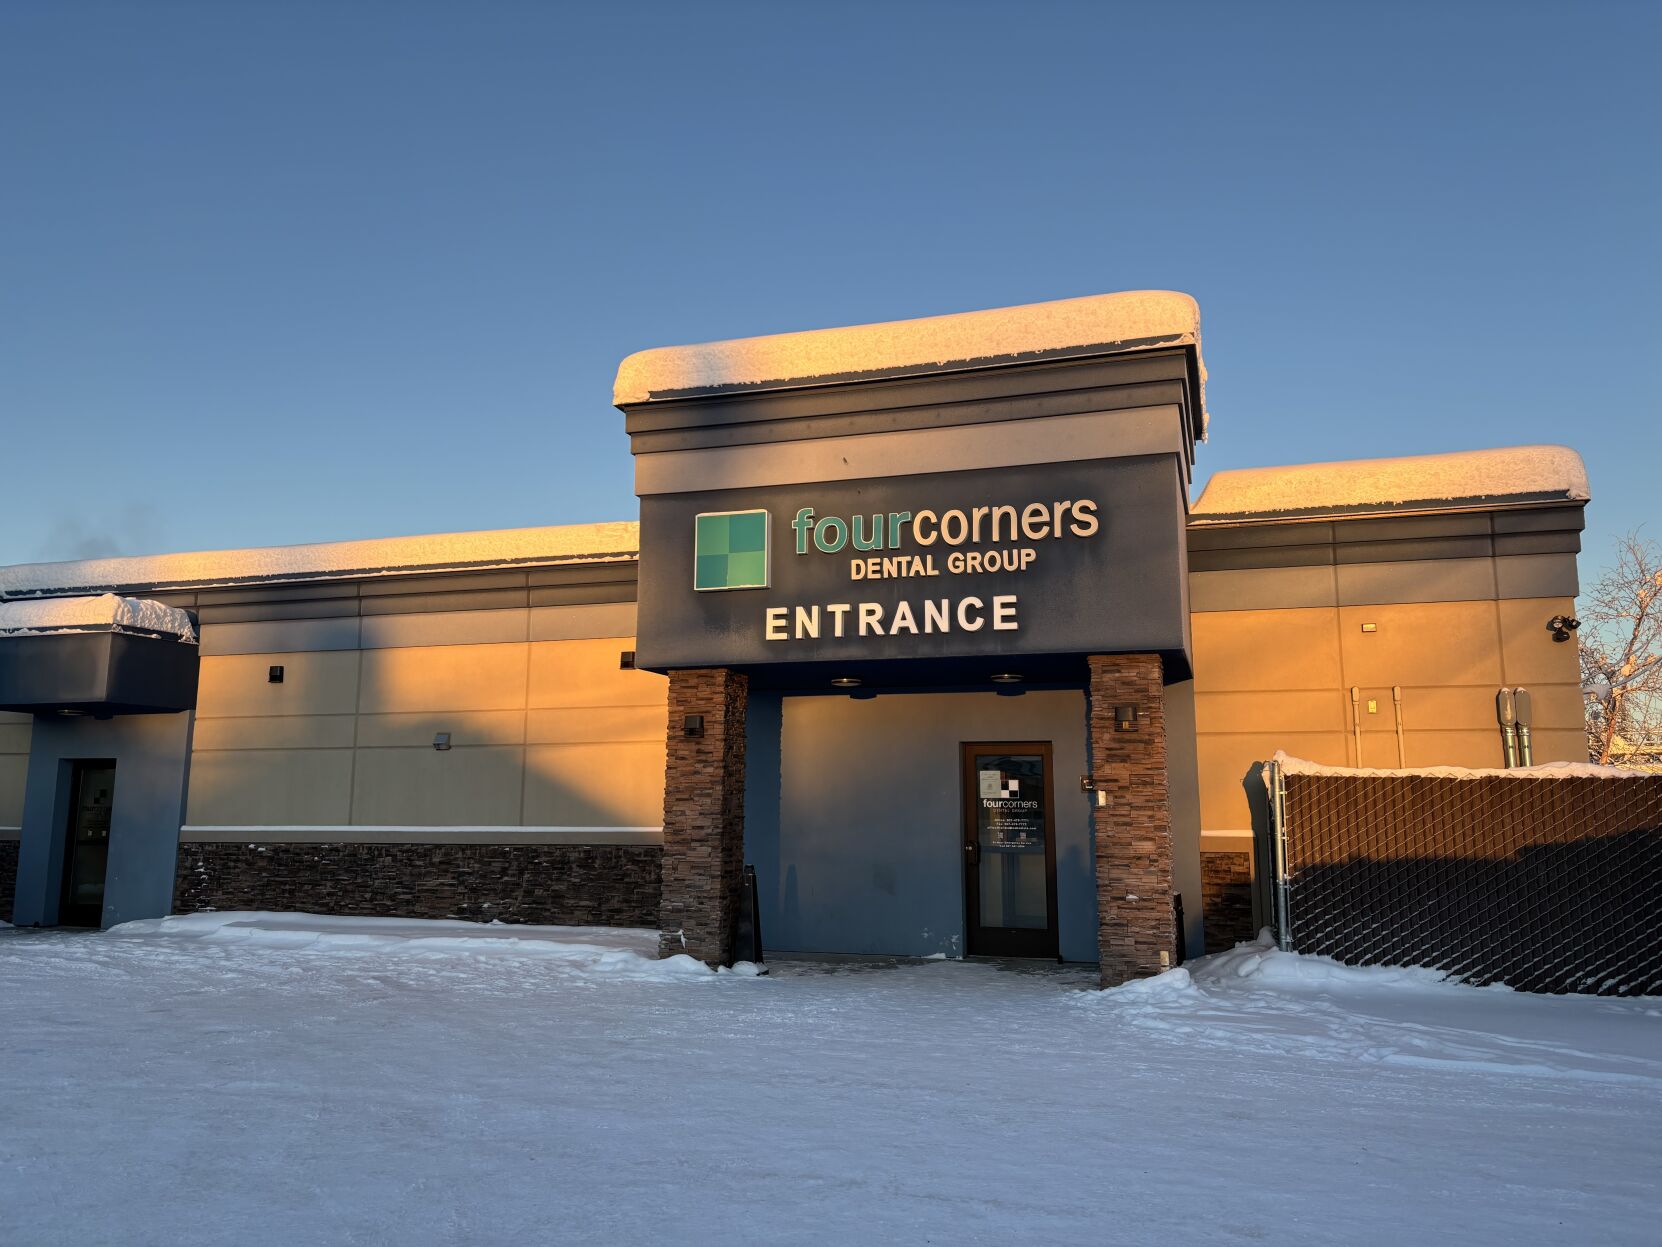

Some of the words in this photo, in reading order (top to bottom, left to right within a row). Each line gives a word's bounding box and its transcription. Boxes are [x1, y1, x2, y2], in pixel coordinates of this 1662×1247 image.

[792, 499, 1099, 554] fourcorners
[850, 554, 940, 581] DENTAL
[947, 548, 1037, 575] GROUP
[765, 595, 1019, 641] ENTRANCE
[983, 799, 1038, 808] fourcorners
